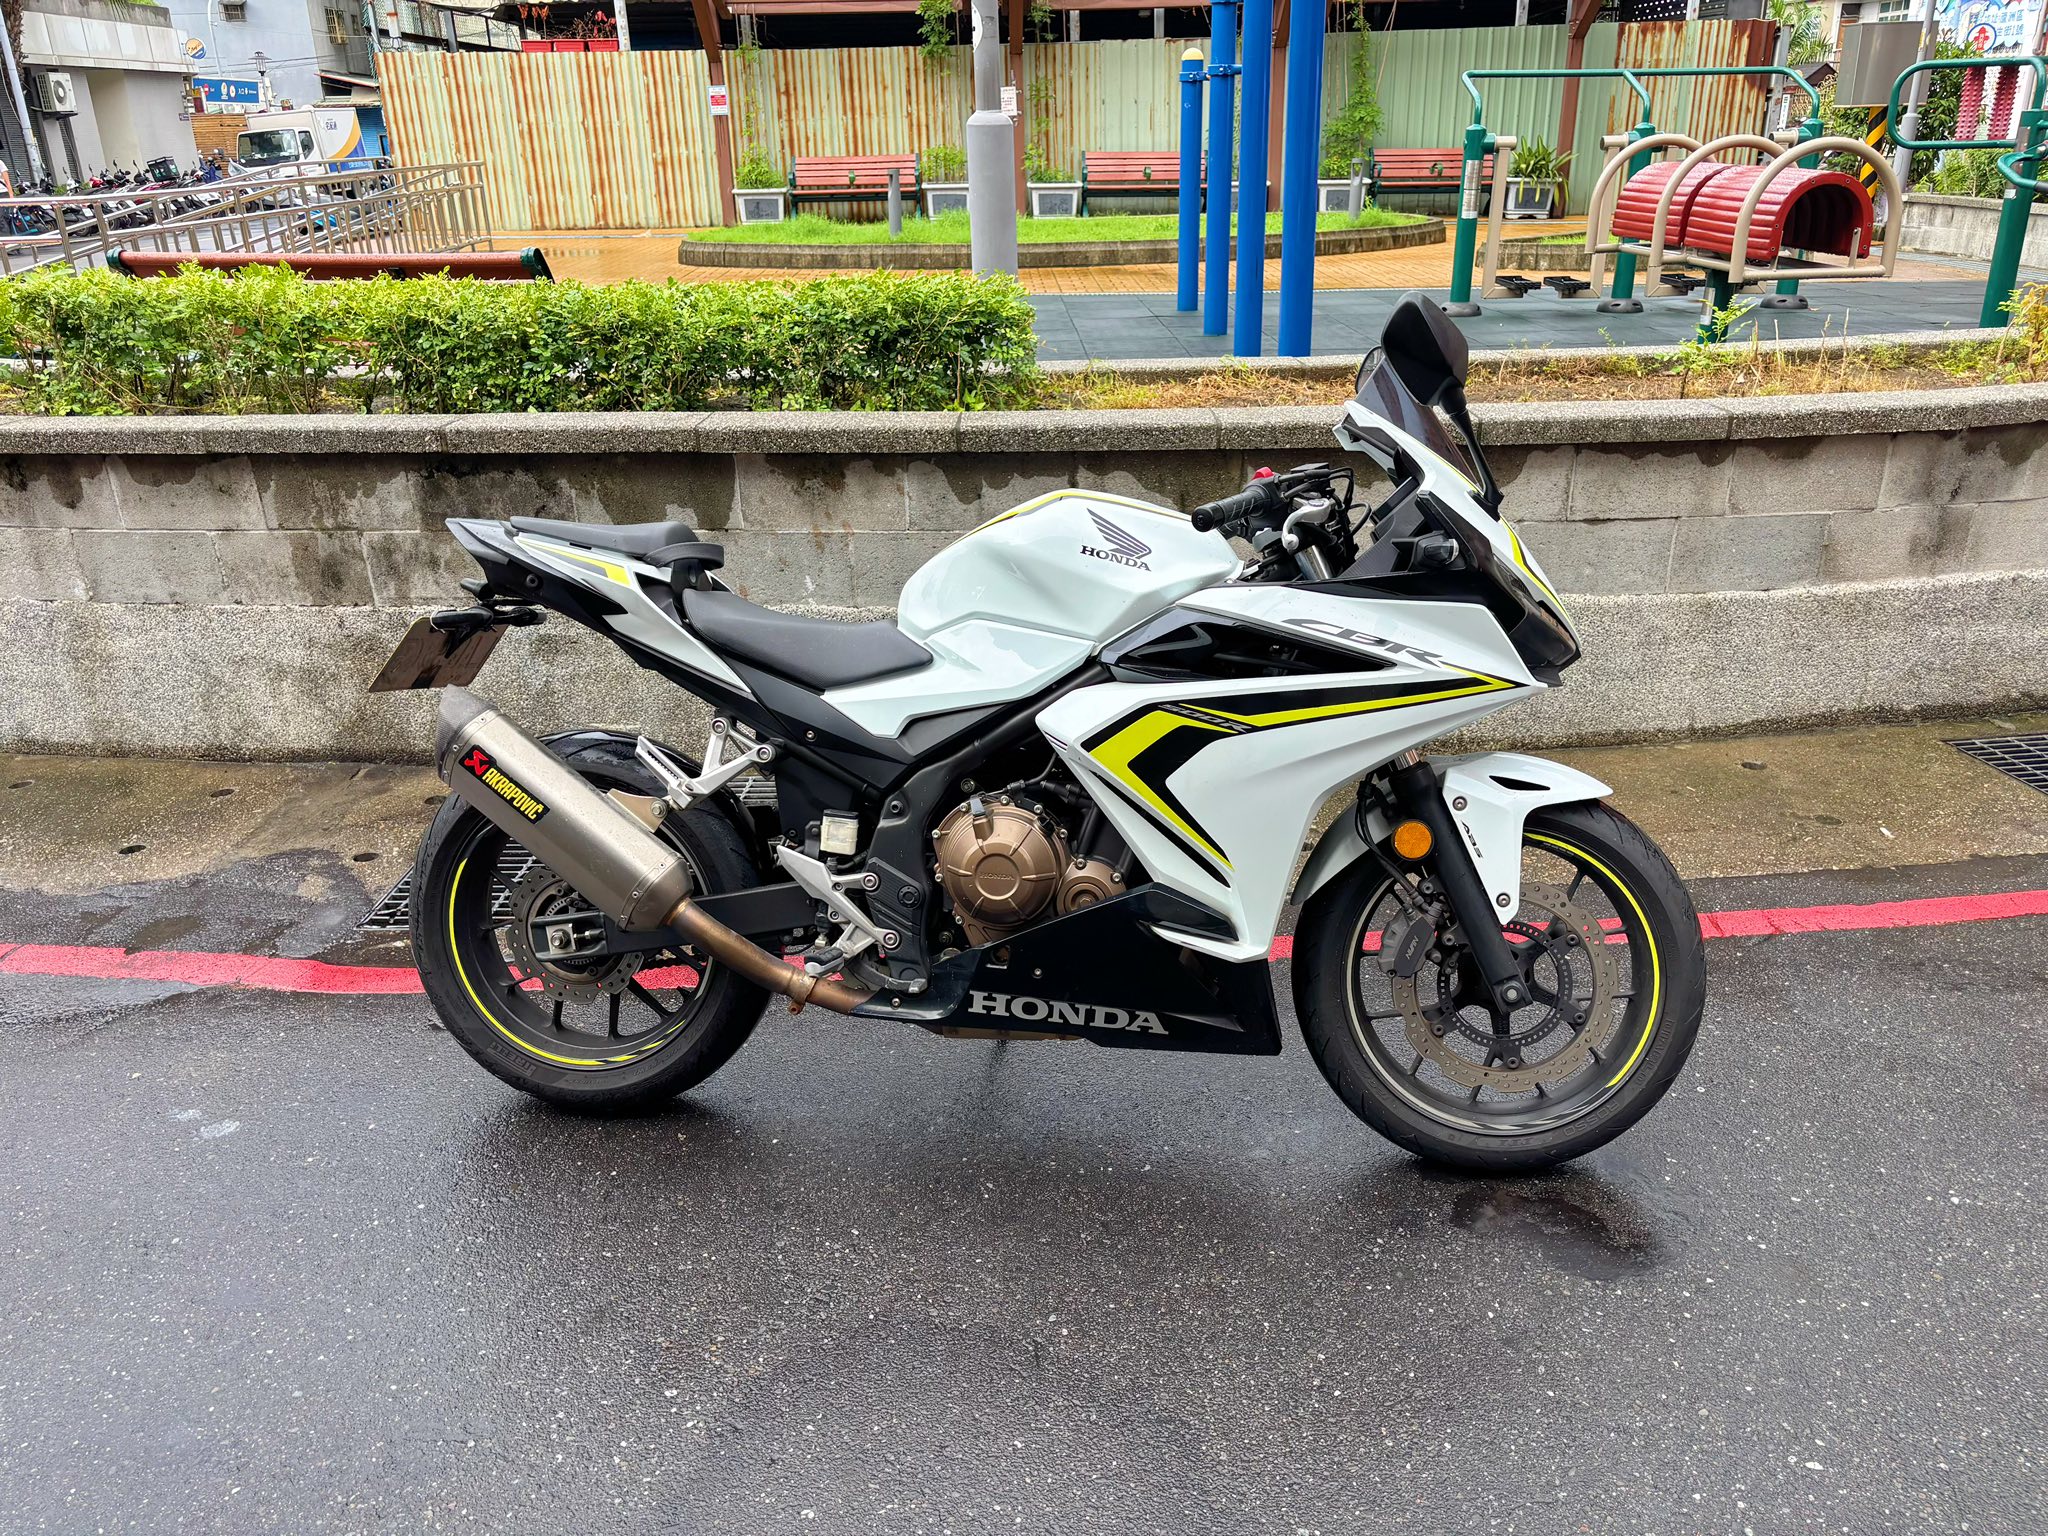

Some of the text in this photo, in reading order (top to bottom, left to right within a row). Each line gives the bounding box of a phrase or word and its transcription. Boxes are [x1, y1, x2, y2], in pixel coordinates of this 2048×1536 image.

[1080, 545, 1152, 572] HONDA
[1282, 619, 1443, 668] CBR
[1460, 820, 1483, 859] ABS
[979, 872, 1015, 881] HONDA
[968, 990, 1169, 1035] HONDA
[1563, 1099, 1620, 1137] ROSSO
